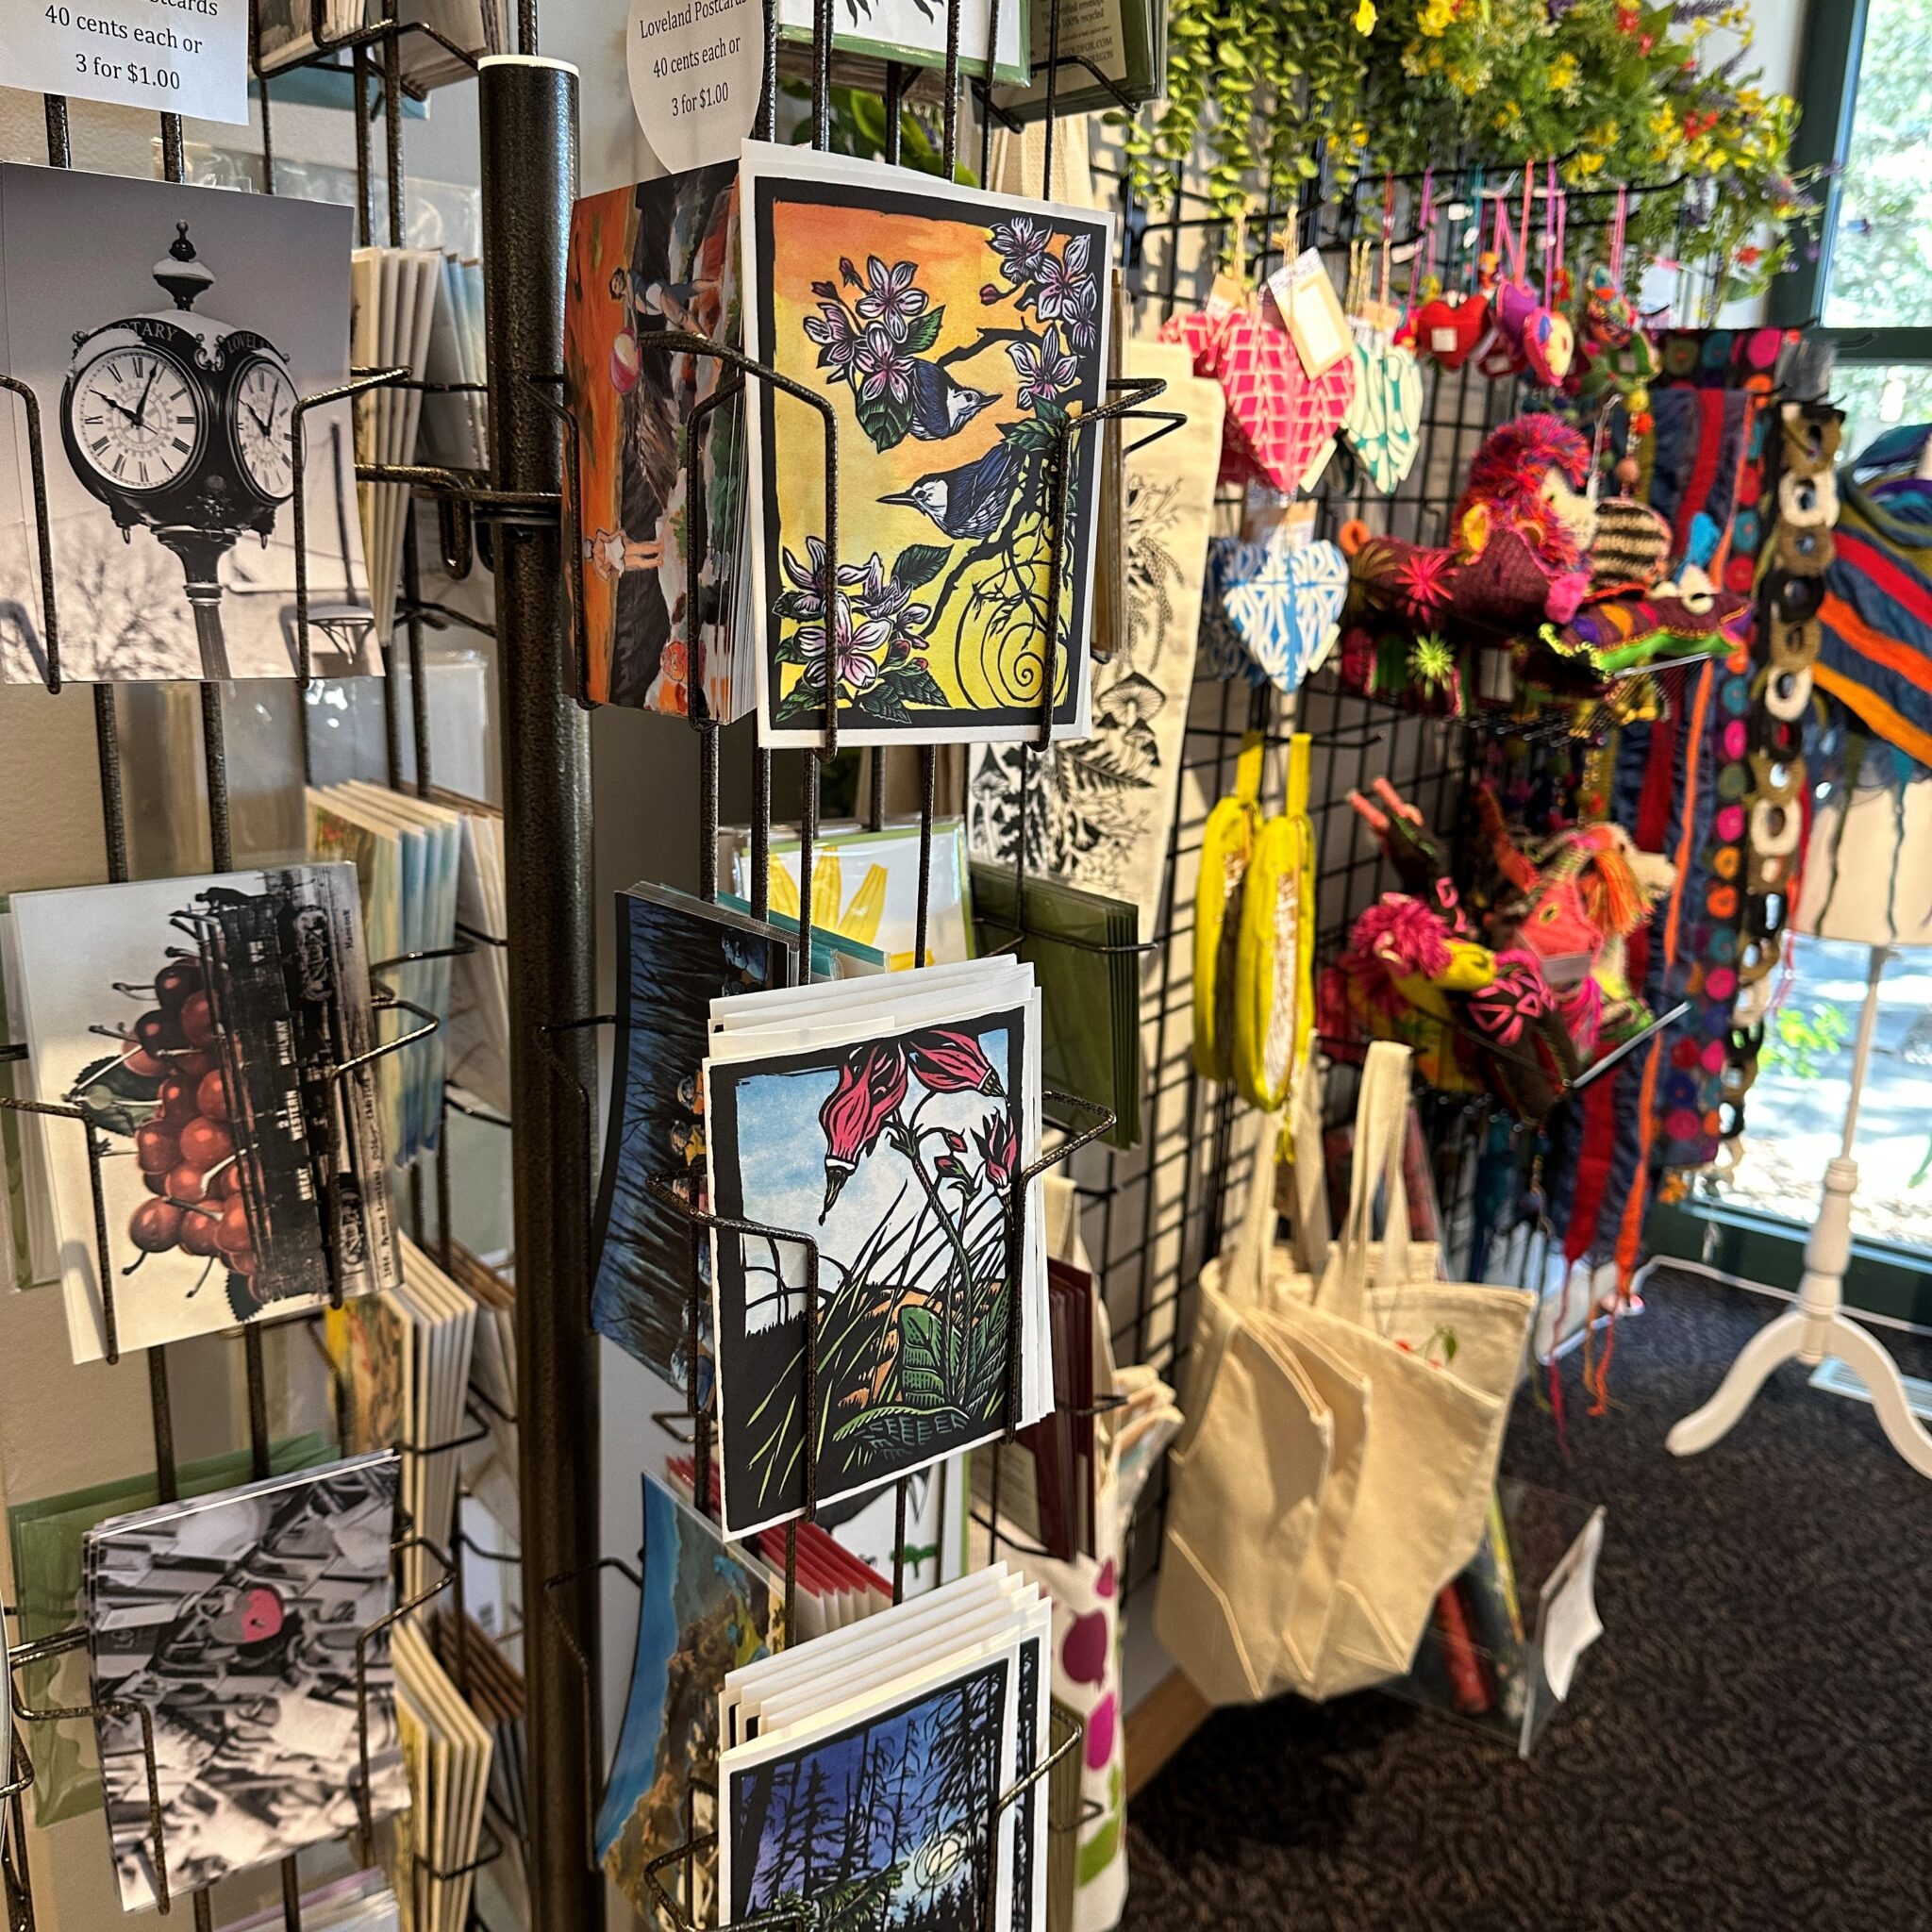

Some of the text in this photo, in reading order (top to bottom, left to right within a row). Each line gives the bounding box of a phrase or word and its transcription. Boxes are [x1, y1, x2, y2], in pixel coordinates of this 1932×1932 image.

[45, 5, 202, 53] 40 cents each or
[640, 4, 691, 39] Loveland
[75, 54, 180, 90] 3 for $1.00
[653, 36, 741, 77] 40 cents each or
[672, 82, 728, 116] 3 for $1.00
[275, 1021, 312, 1200] GREAT WESTERN RAILWAY
